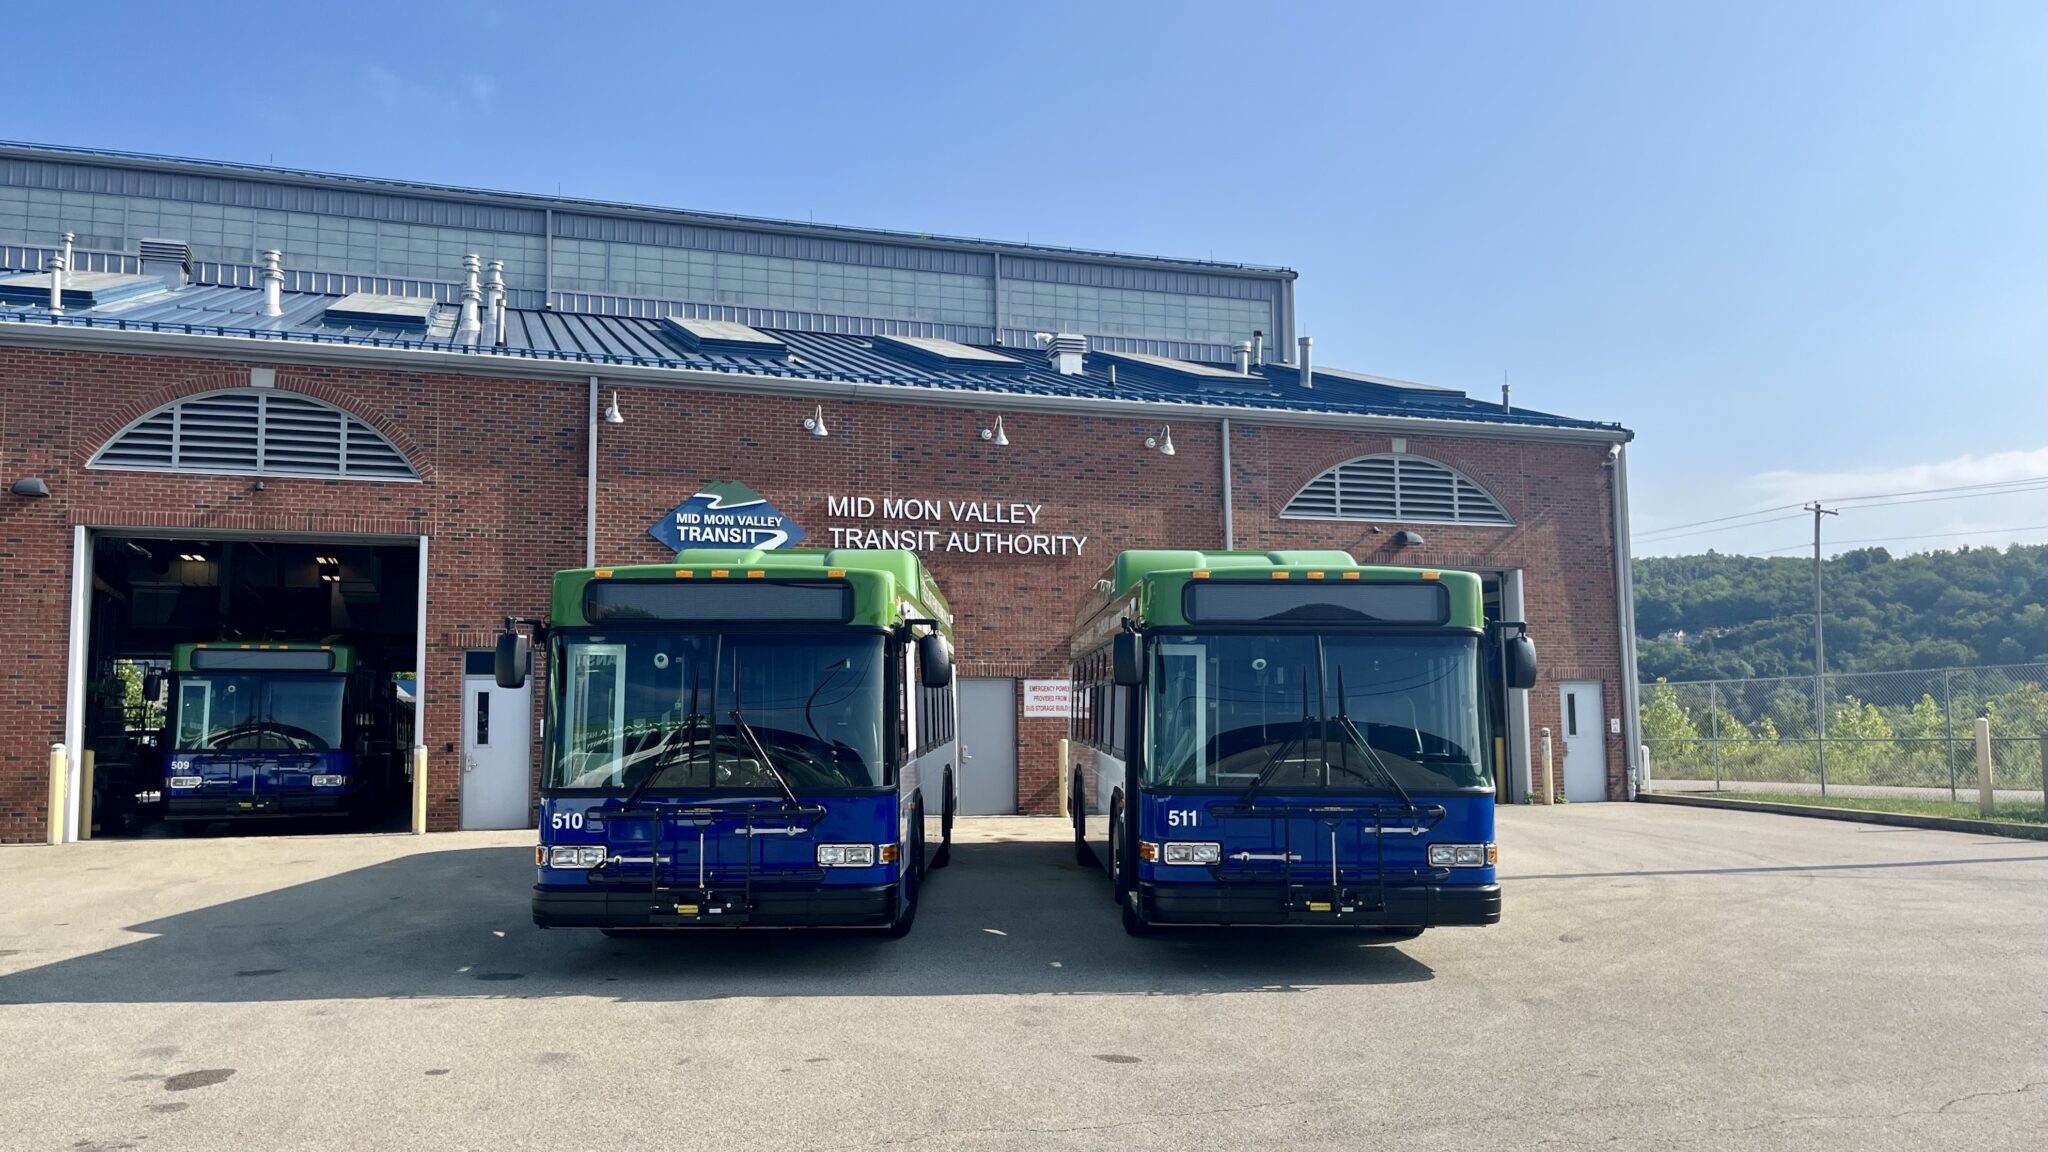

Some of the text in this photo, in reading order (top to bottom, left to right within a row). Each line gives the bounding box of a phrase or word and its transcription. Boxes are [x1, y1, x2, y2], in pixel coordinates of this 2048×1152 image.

[828, 496, 1042, 524] MID MON VALLEY
[676, 513, 783, 527] MID MON VALLEY
[676, 526, 757, 544] TRANSIT
[828, 527, 1087, 556] TRANSIT AUTHORITY
[171, 760, 190, 770] 509
[552, 812, 583, 830] 510
[1168, 809, 1197, 826] 511
